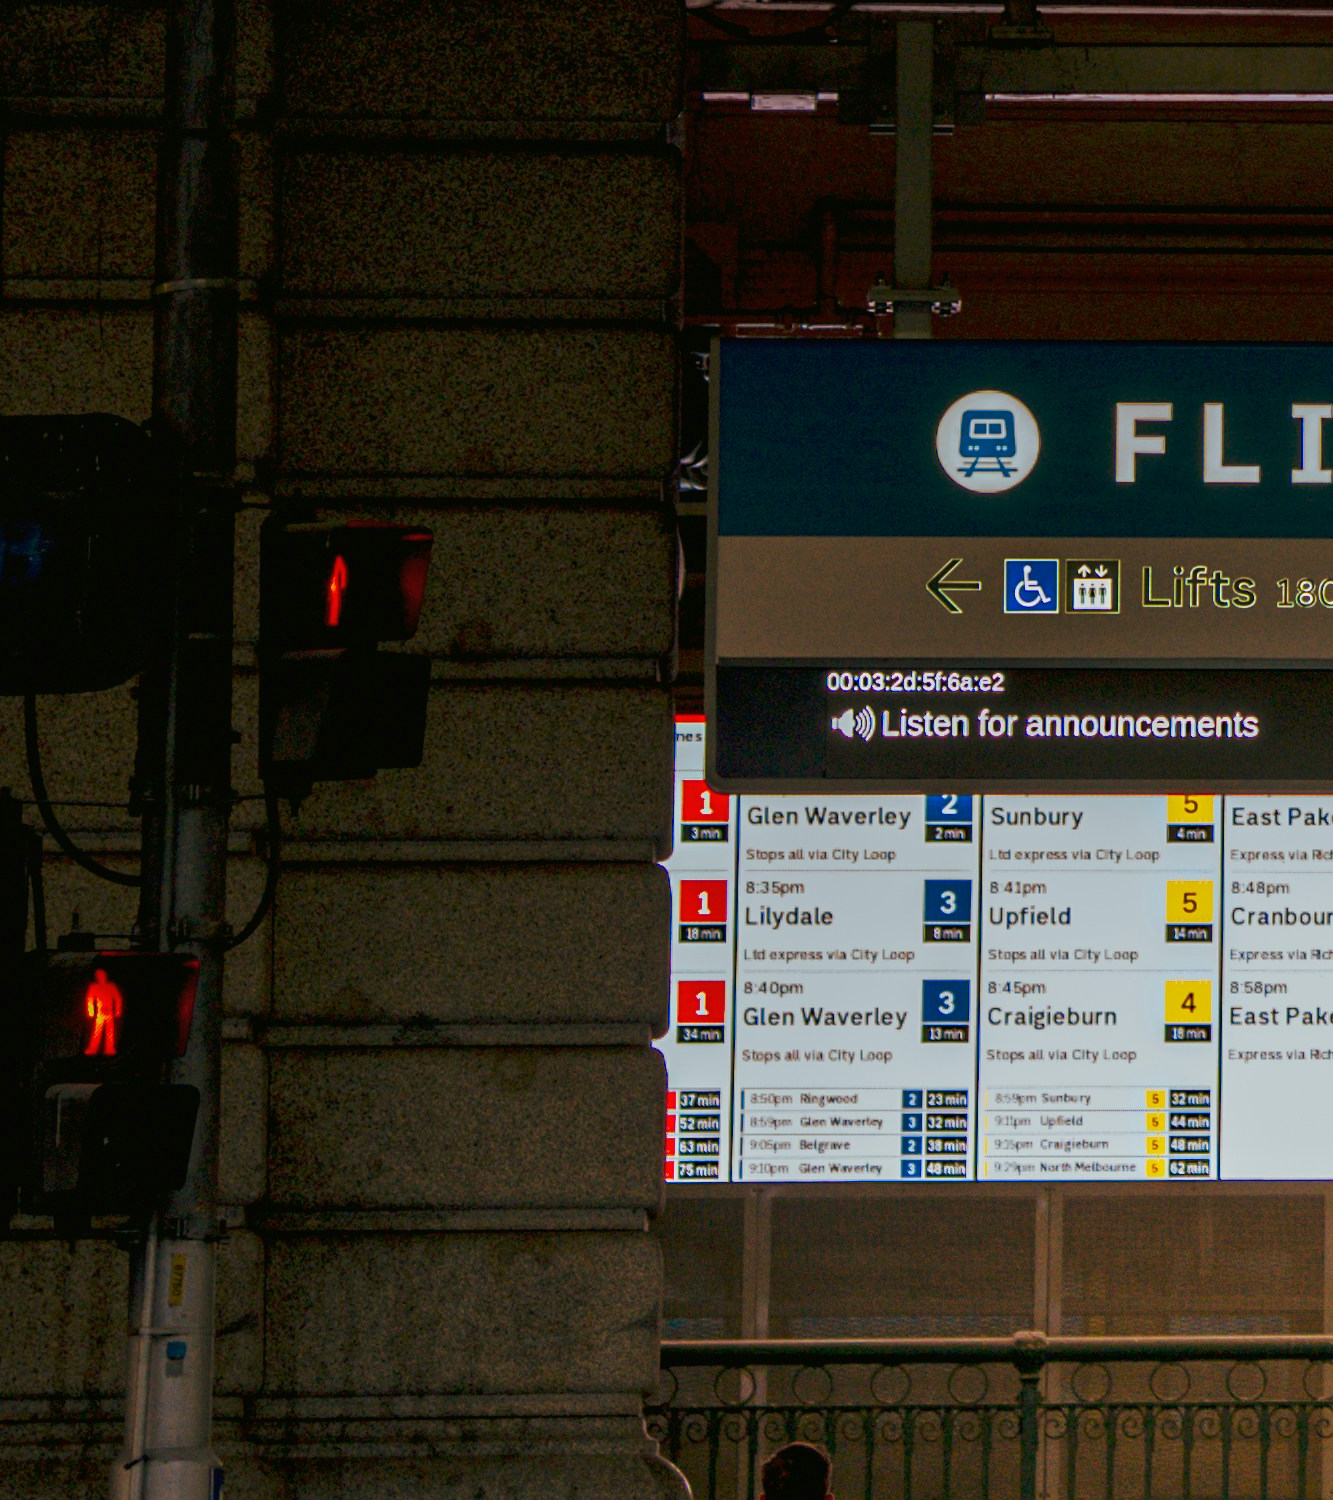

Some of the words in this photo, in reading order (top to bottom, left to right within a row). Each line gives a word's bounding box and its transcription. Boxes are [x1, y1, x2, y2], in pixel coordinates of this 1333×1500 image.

[1141, 564, 1257, 610] Lifts
[826, 671, 1005, 693] 00:03:2d:5f:6a:e2
[882, 709, 968, 738] Listen
[977, 709, 1018, 738] for
[1026, 712, 1260, 738] announcements
[941, 793, 958, 815] 2
[1183, 794, 1199, 814] 5
[748, 806, 798, 825] Glen
[805, 806, 911, 831] Waverley
[991, 807, 1084, 829] Sunbury
[1231, 807, 1281, 826] East
[934, 828, 943, 840] 2
[944, 828, 964, 840] min
[1176, 827, 1185, 839] 4
[1186, 827, 1207, 839] min
[746, 848, 785, 862] Stops
[788, 848, 805, 860] all
[808, 848, 827, 860] via
[832, 848, 859, 862] City
[863, 848, 897, 862] Loop
[1014, 850, 1068, 863] express
[1072, 849, 1091, 860] via
[1096, 849, 1122, 863] City
[1126, 849, 1160, 863] Loop
[1230, 850, 1285, 863] Express
[1288, 850, 1308, 861] via
[745, 880, 805, 896] 8:35pm
[1231, 880, 1290, 897] 8:48pm
[939, 891, 957, 914] 3
[1182, 892, 1198, 914] 5
[745, 906, 833, 930] Lilydale
[989, 906, 1072, 930] Upfield
[743, 981, 804, 996] 8:40pm
[1230, 980, 1288, 997] 8:58pm
[694, 991, 709, 1016] 1
[938, 990, 956, 1015] 3
[1180, 992, 1197, 1013] 4
[743, 1007, 795, 1026] Glen
[801, 1007, 908, 1030] Waverley
[987, 1006, 1117, 1030] Craigieburn
[1230, 1007, 1280, 1026] East
[681, 1028, 699, 1041] 34
[700, 1028, 721, 1041] min
[928, 1028, 941, 1040] 13
[943, 1028, 963, 1040] min
[986, 1049, 1024, 1063] Stops
[1028, 1049, 1044, 1061] all
[1048, 1049, 1067, 1061] via
[1072, 1049, 1099, 1064] City
[1103, 1049, 1137, 1063] Loop
